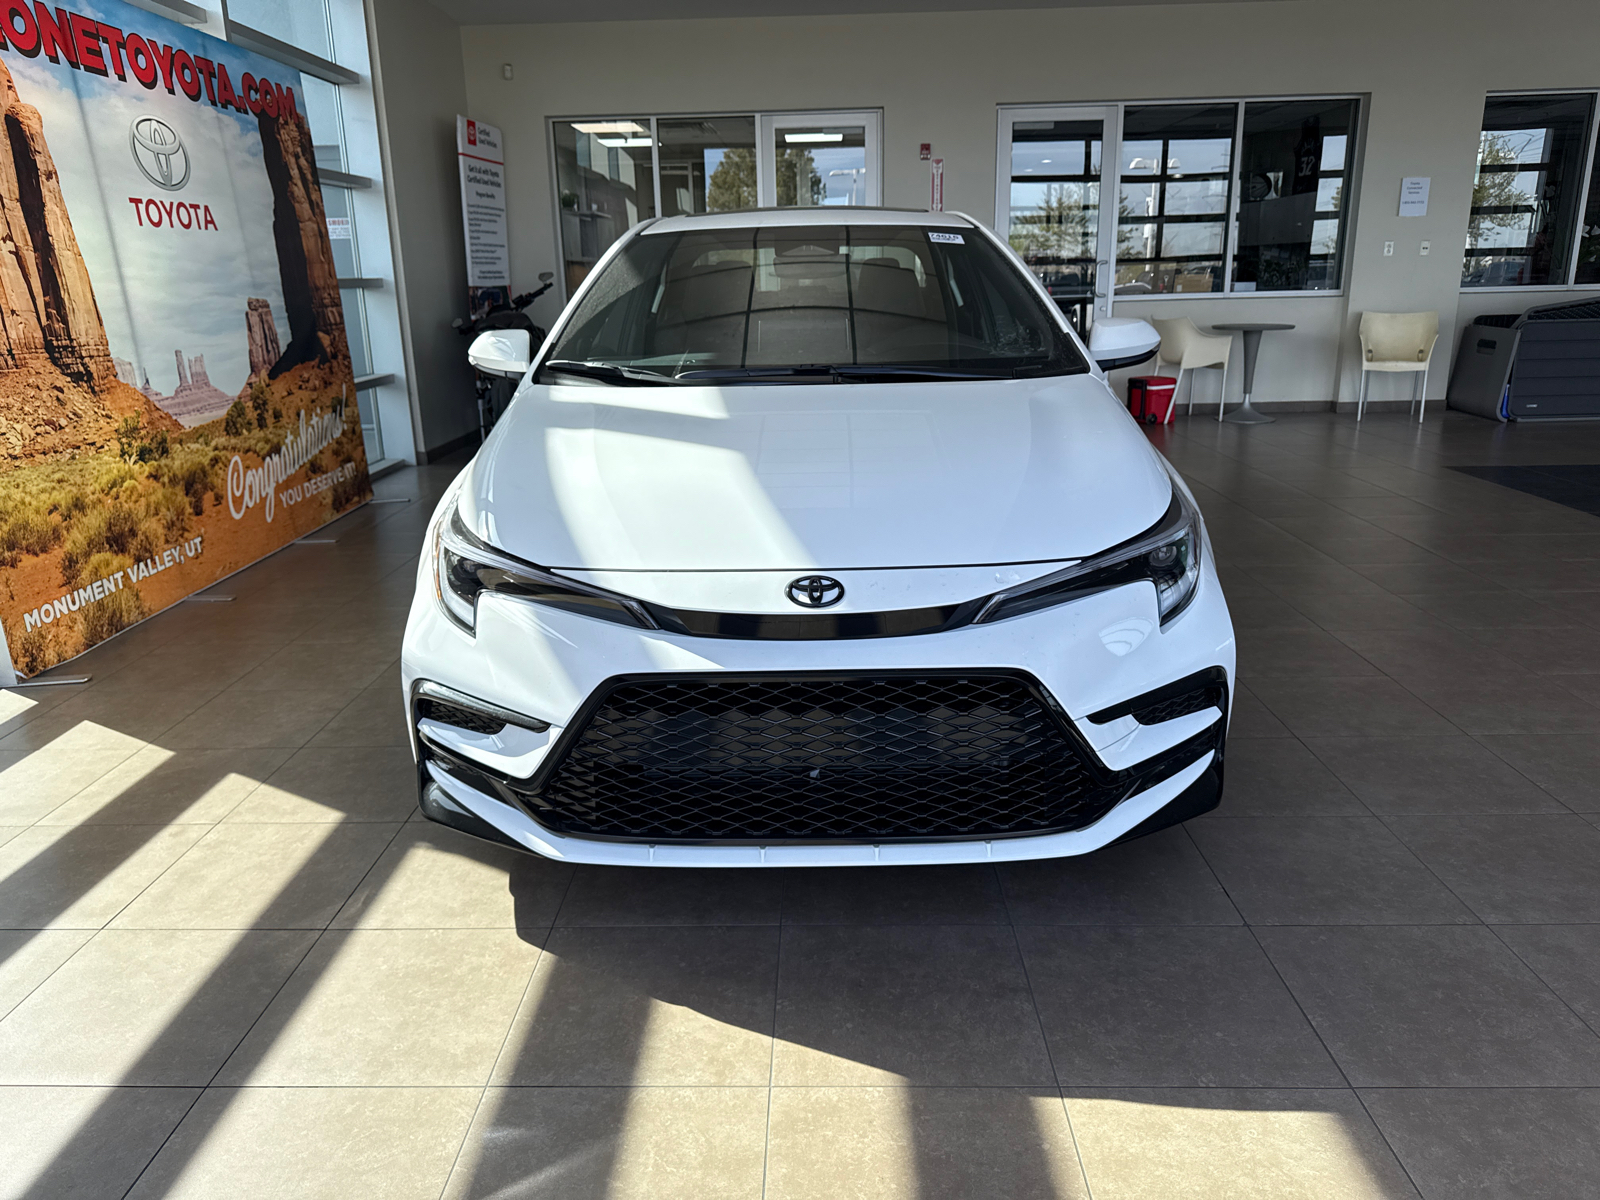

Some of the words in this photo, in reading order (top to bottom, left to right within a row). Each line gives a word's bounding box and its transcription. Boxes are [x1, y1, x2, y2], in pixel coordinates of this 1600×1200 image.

[0, 0, 300, 124] ONETOYOTA.COM
[1298, 155, 1316, 177] 32
[128, 197, 219, 232] TOYOTA
[227, 382, 348, 523] Congratulations!
[280, 485, 303, 508] YOU
[303, 466, 345, 498] DESERVE
[23, 571, 124, 633] MONUMENT
[127, 545, 185, 583] VALLEY,
[185, 536, 202, 558] UT
